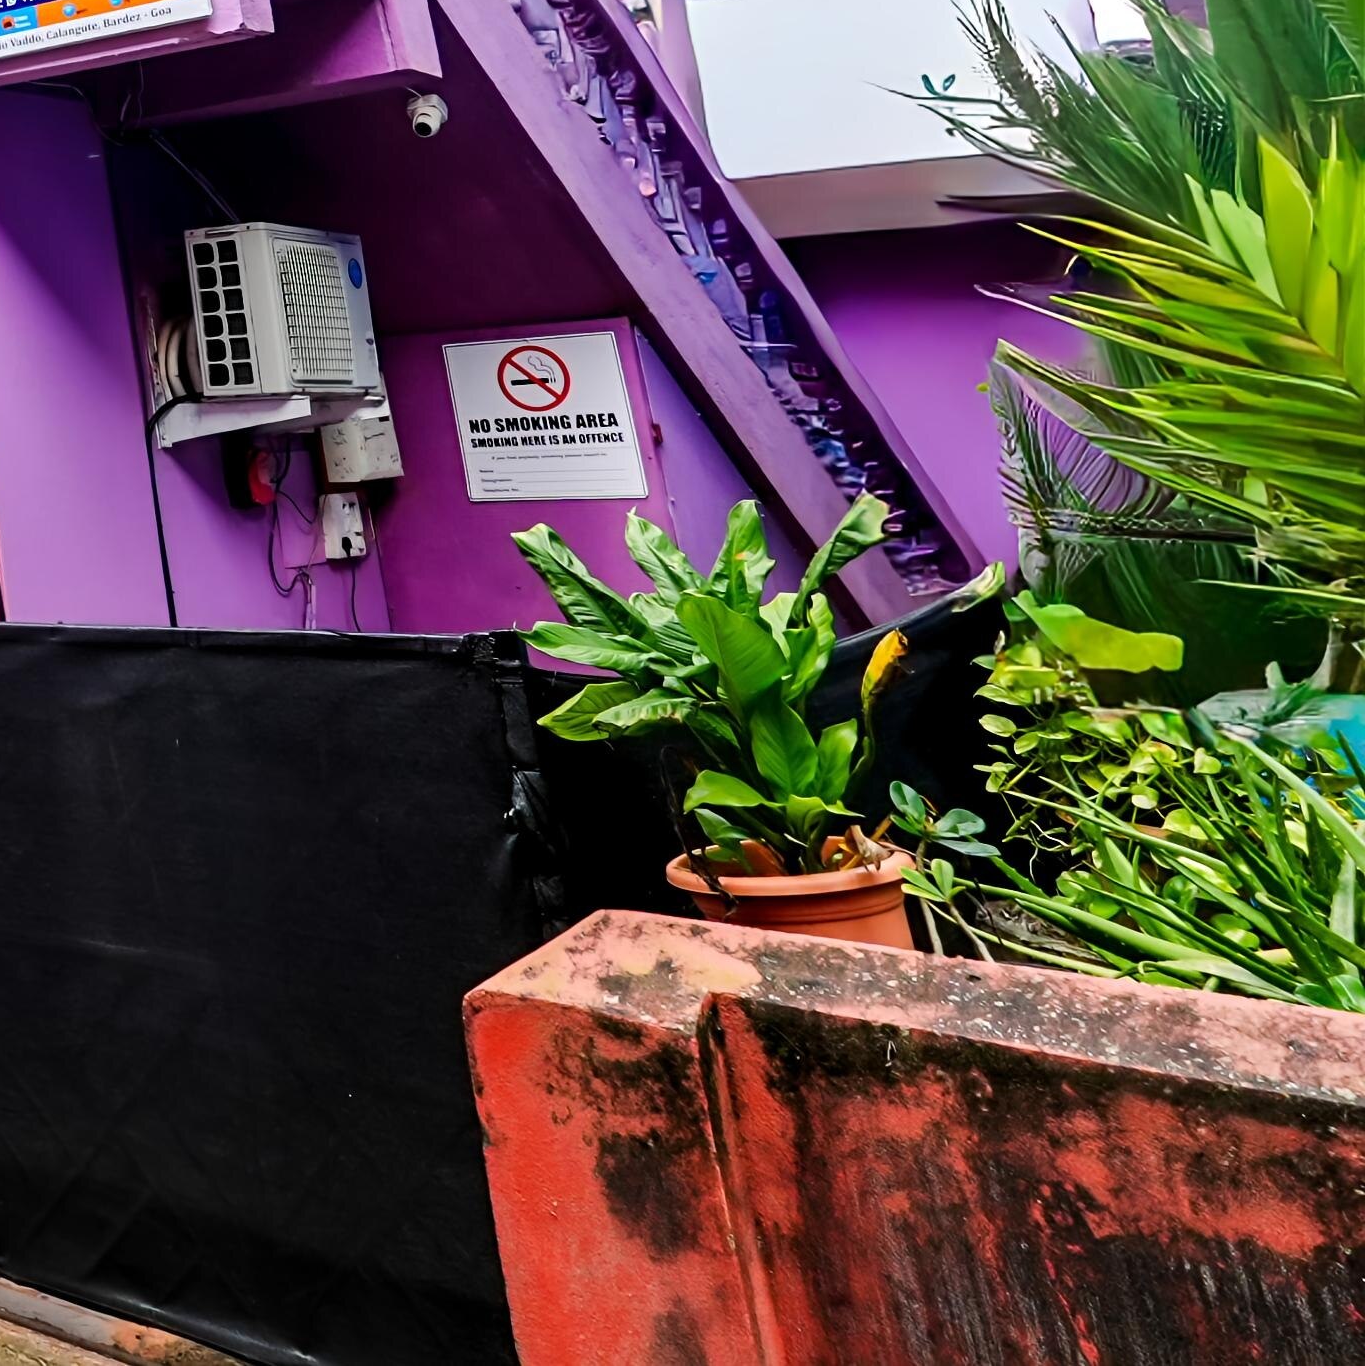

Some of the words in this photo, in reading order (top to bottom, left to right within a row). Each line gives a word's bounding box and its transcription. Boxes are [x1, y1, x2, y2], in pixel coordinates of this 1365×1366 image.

[103, 13, 141, 28] Bardez
[150, 6, 172, 18] Goa
[469, 419, 491, 434] NO
[494, 415, 571, 433] SMOKING
[576, 412, 619, 428] AREA
[471, 437, 518, 448] SMOKING
[521, 435, 546, 446] HERE
[549, 435, 560, 445] IS
[562, 434, 576, 445] AN
[579, 432, 624, 444] OFFENCE
